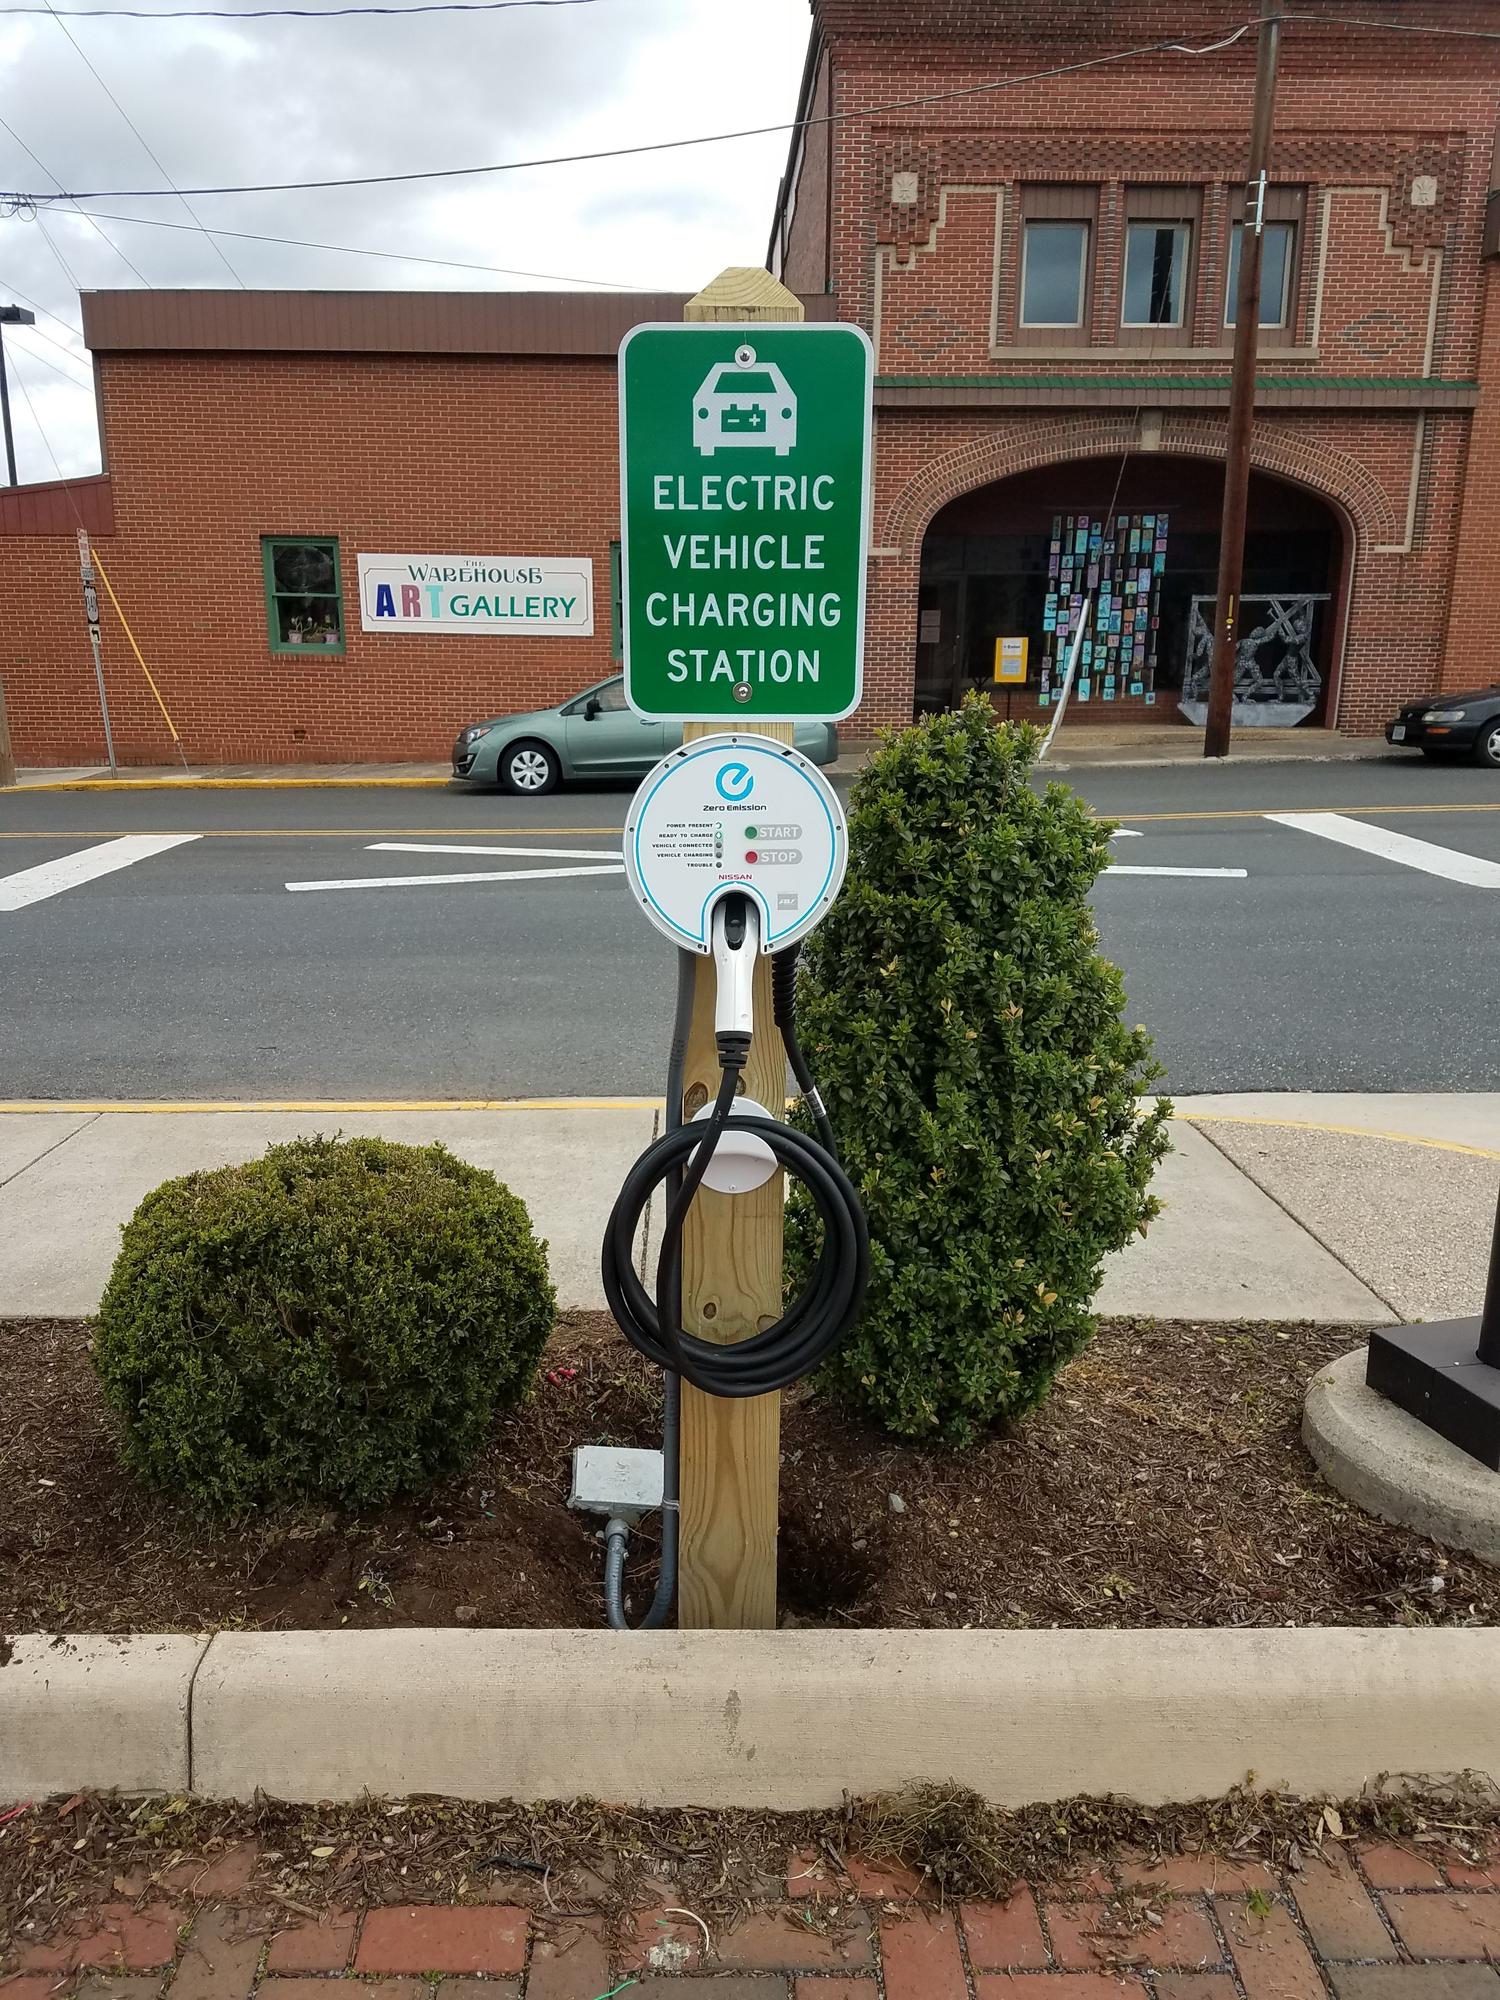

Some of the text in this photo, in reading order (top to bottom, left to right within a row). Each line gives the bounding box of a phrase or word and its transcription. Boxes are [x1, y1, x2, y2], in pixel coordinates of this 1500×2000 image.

[653, 474, 835, 511] ELECTRIC
[463, 559, 486, 567] THE
[663, 534, 825, 570] VEHICLE
[407, 564, 543, 585] WAREHOUSE
[375, 583, 577, 618] ART GALLERY
[646, 592, 841, 627] CHARGING
[667, 649, 820, 684] STATION
[726, 804, 767, 812] Emission
[759, 827, 799, 837] START
[761, 852, 797, 862] STOP
